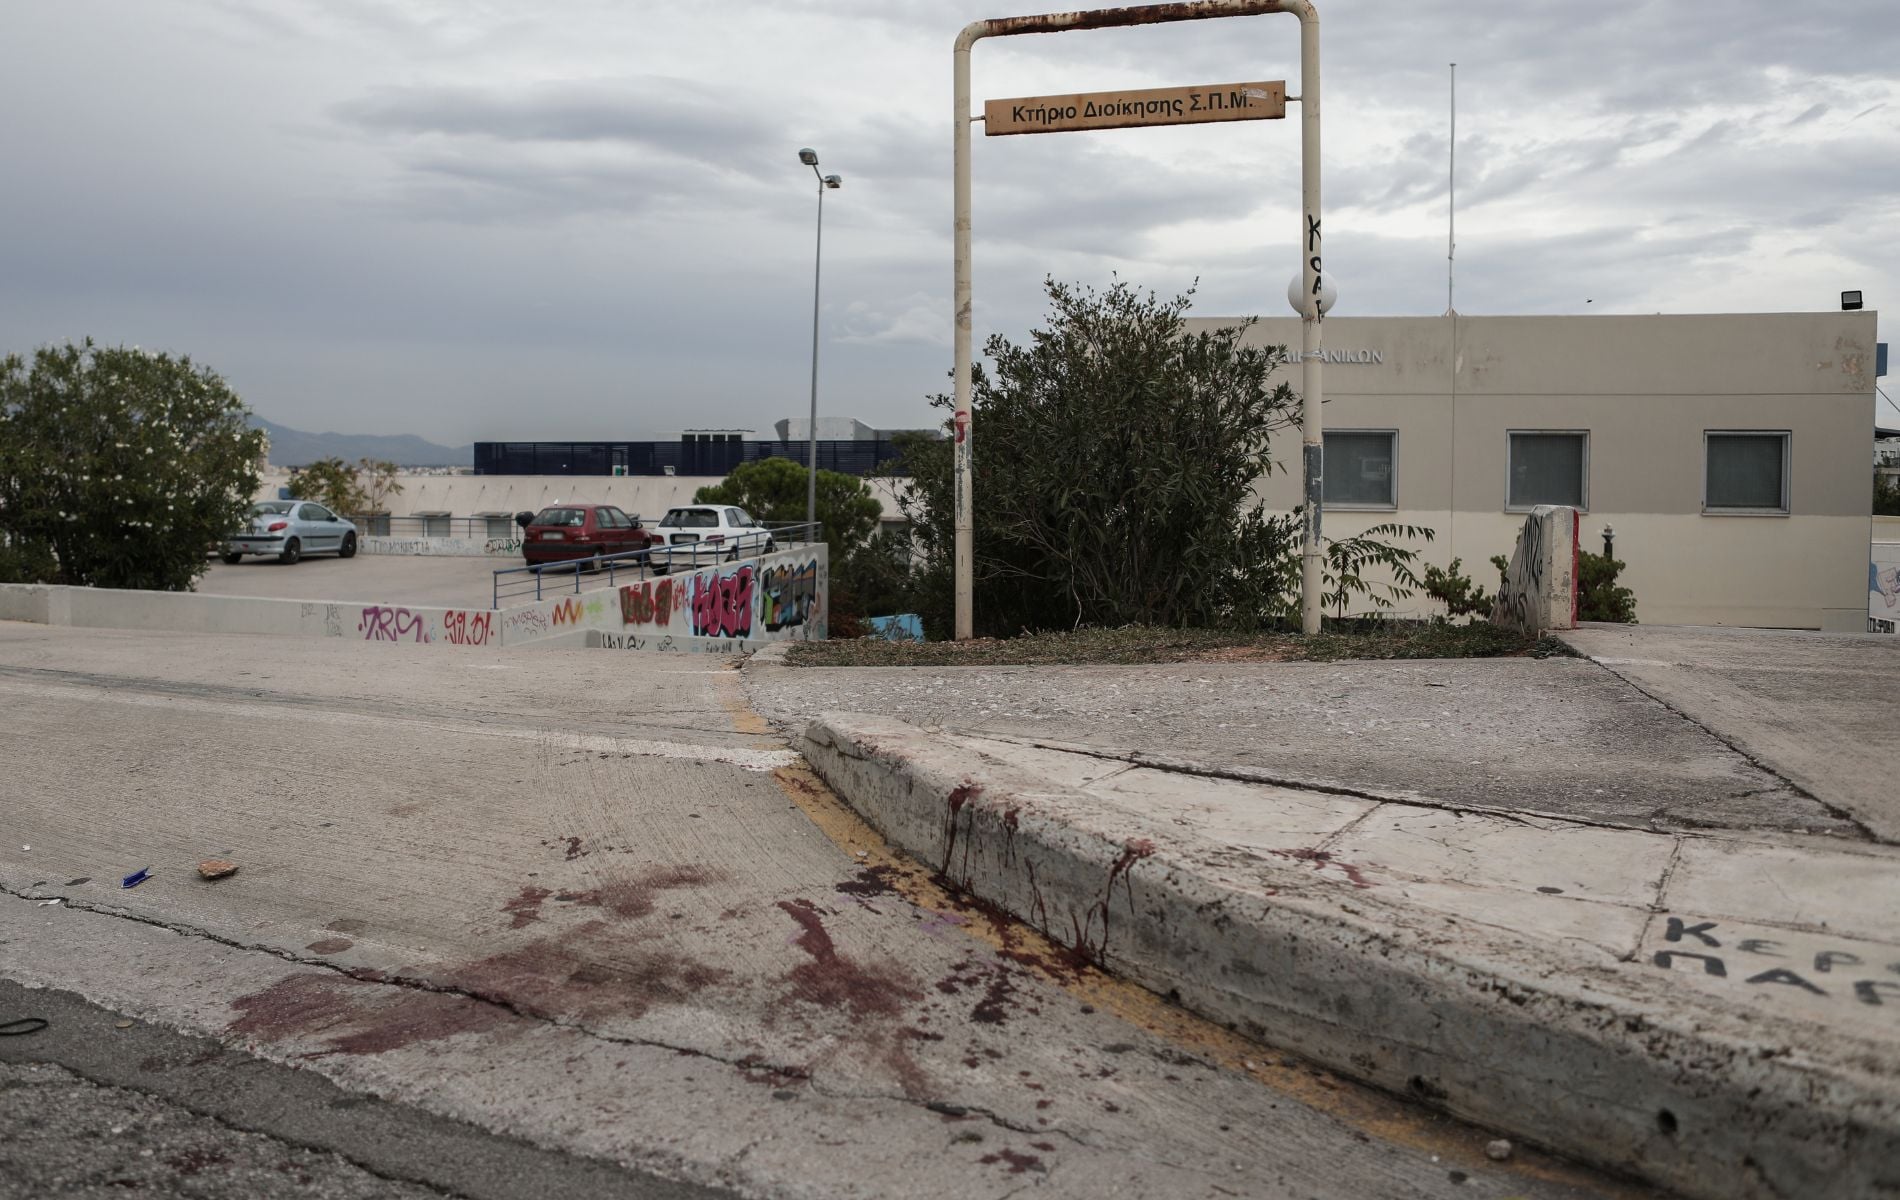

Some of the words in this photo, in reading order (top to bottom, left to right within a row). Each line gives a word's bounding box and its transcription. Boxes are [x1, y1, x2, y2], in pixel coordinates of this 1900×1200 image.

[1012, 104, 1077, 125] Κτήριο
[1084, 99, 1183, 119] Διοίκησης
[1189, 91, 1253, 111] Σ.Π.Μ.
[1664, 917, 1900, 975] ΚΕΡ
